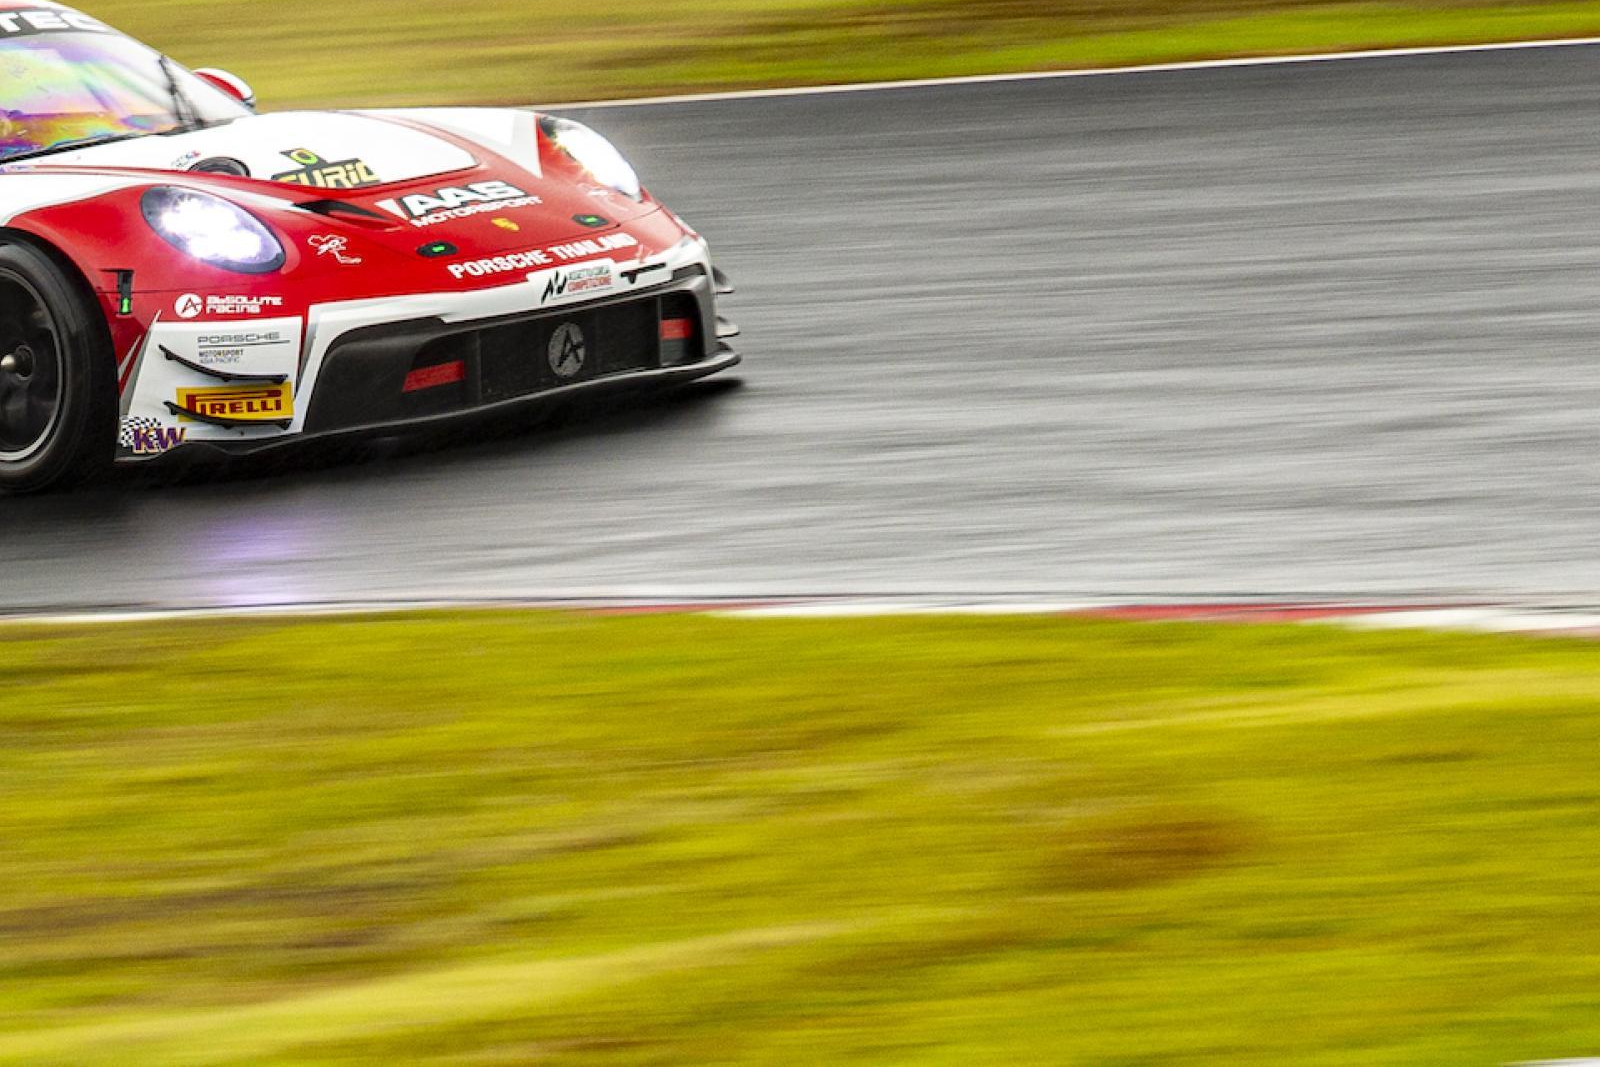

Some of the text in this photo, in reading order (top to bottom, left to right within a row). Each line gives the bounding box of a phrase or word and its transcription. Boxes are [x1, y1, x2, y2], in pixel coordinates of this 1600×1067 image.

[399, 181, 528, 219] AAS
[447, 249, 553, 280] PORSCHE
[547, 233, 638, 260] THAILAND
[197, 332, 280, 344] PORSCHE
[186, 389, 282, 416] PIRELLI
